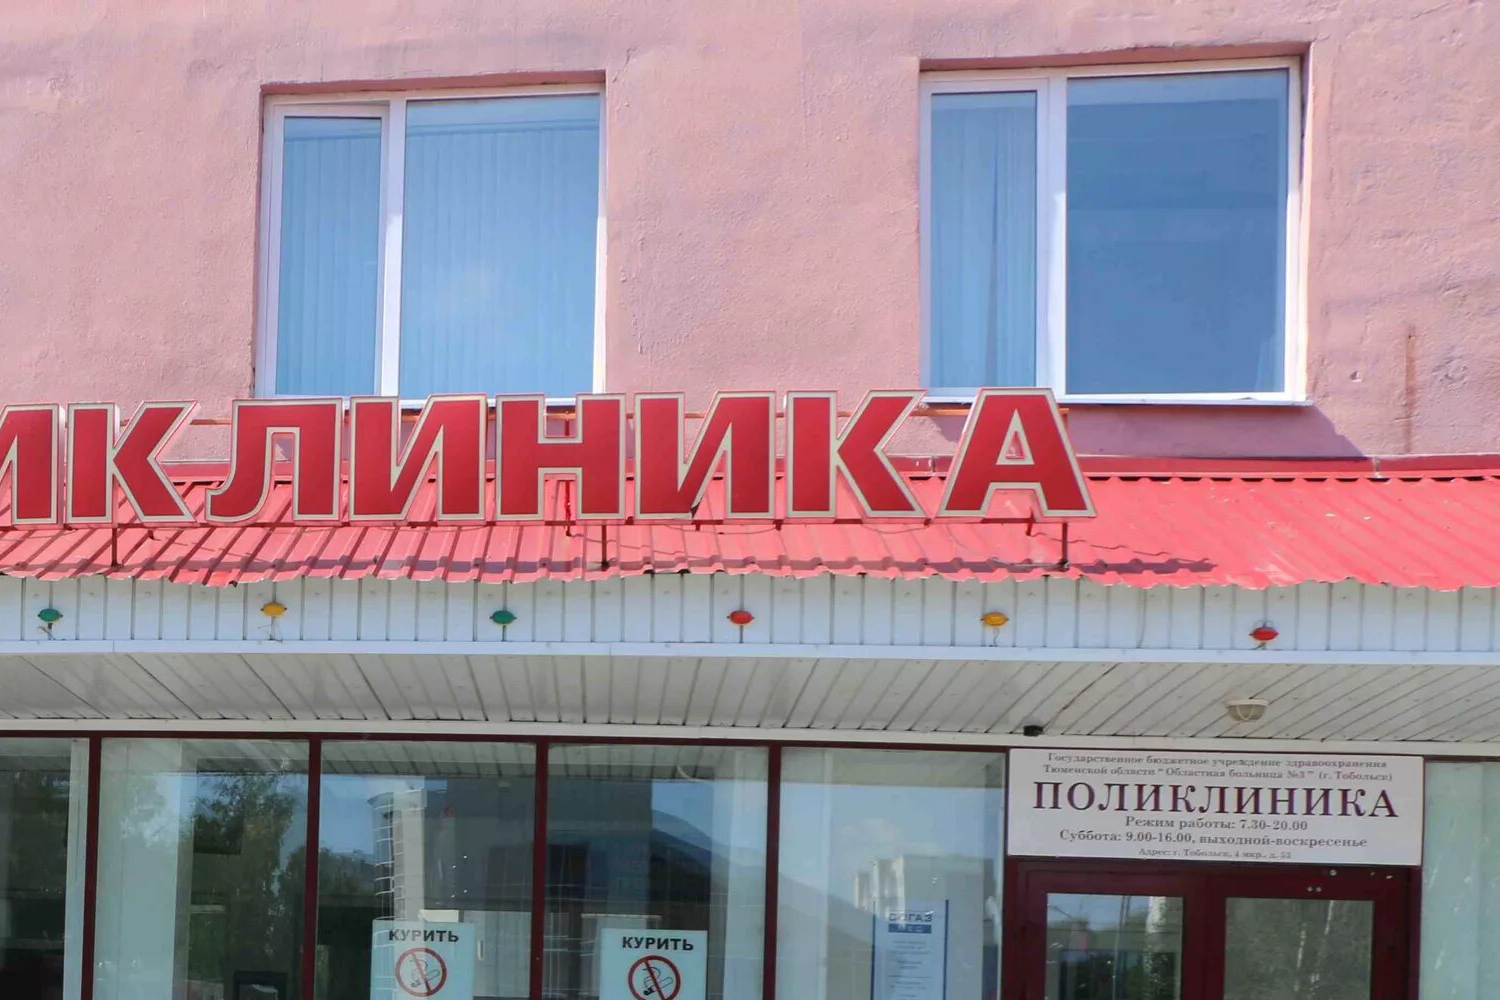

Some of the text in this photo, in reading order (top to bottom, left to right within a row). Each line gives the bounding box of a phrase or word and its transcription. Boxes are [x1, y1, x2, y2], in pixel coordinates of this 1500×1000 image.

[1047, 752, 1388, 770] Государственное бюджетное учреждение здравоохранения
[1043, 764, 1108, 775] Тюменской
[1110, 765, 1156, 776] области
[1228, 768, 1283, 779] больница
[1032, 781, 1399, 818] ПОЛИКЛИНИКА
[1124, 816, 1308, 831] Режим работы: 7.30-20.00
[1059, 829, 1122, 843] Суббота:
[1199, 834, 1368, 848] выходной-воскресенье
[389, 930, 459, 944] КУРИТЬ
[622, 936, 694, 951] КУРИТЬ
